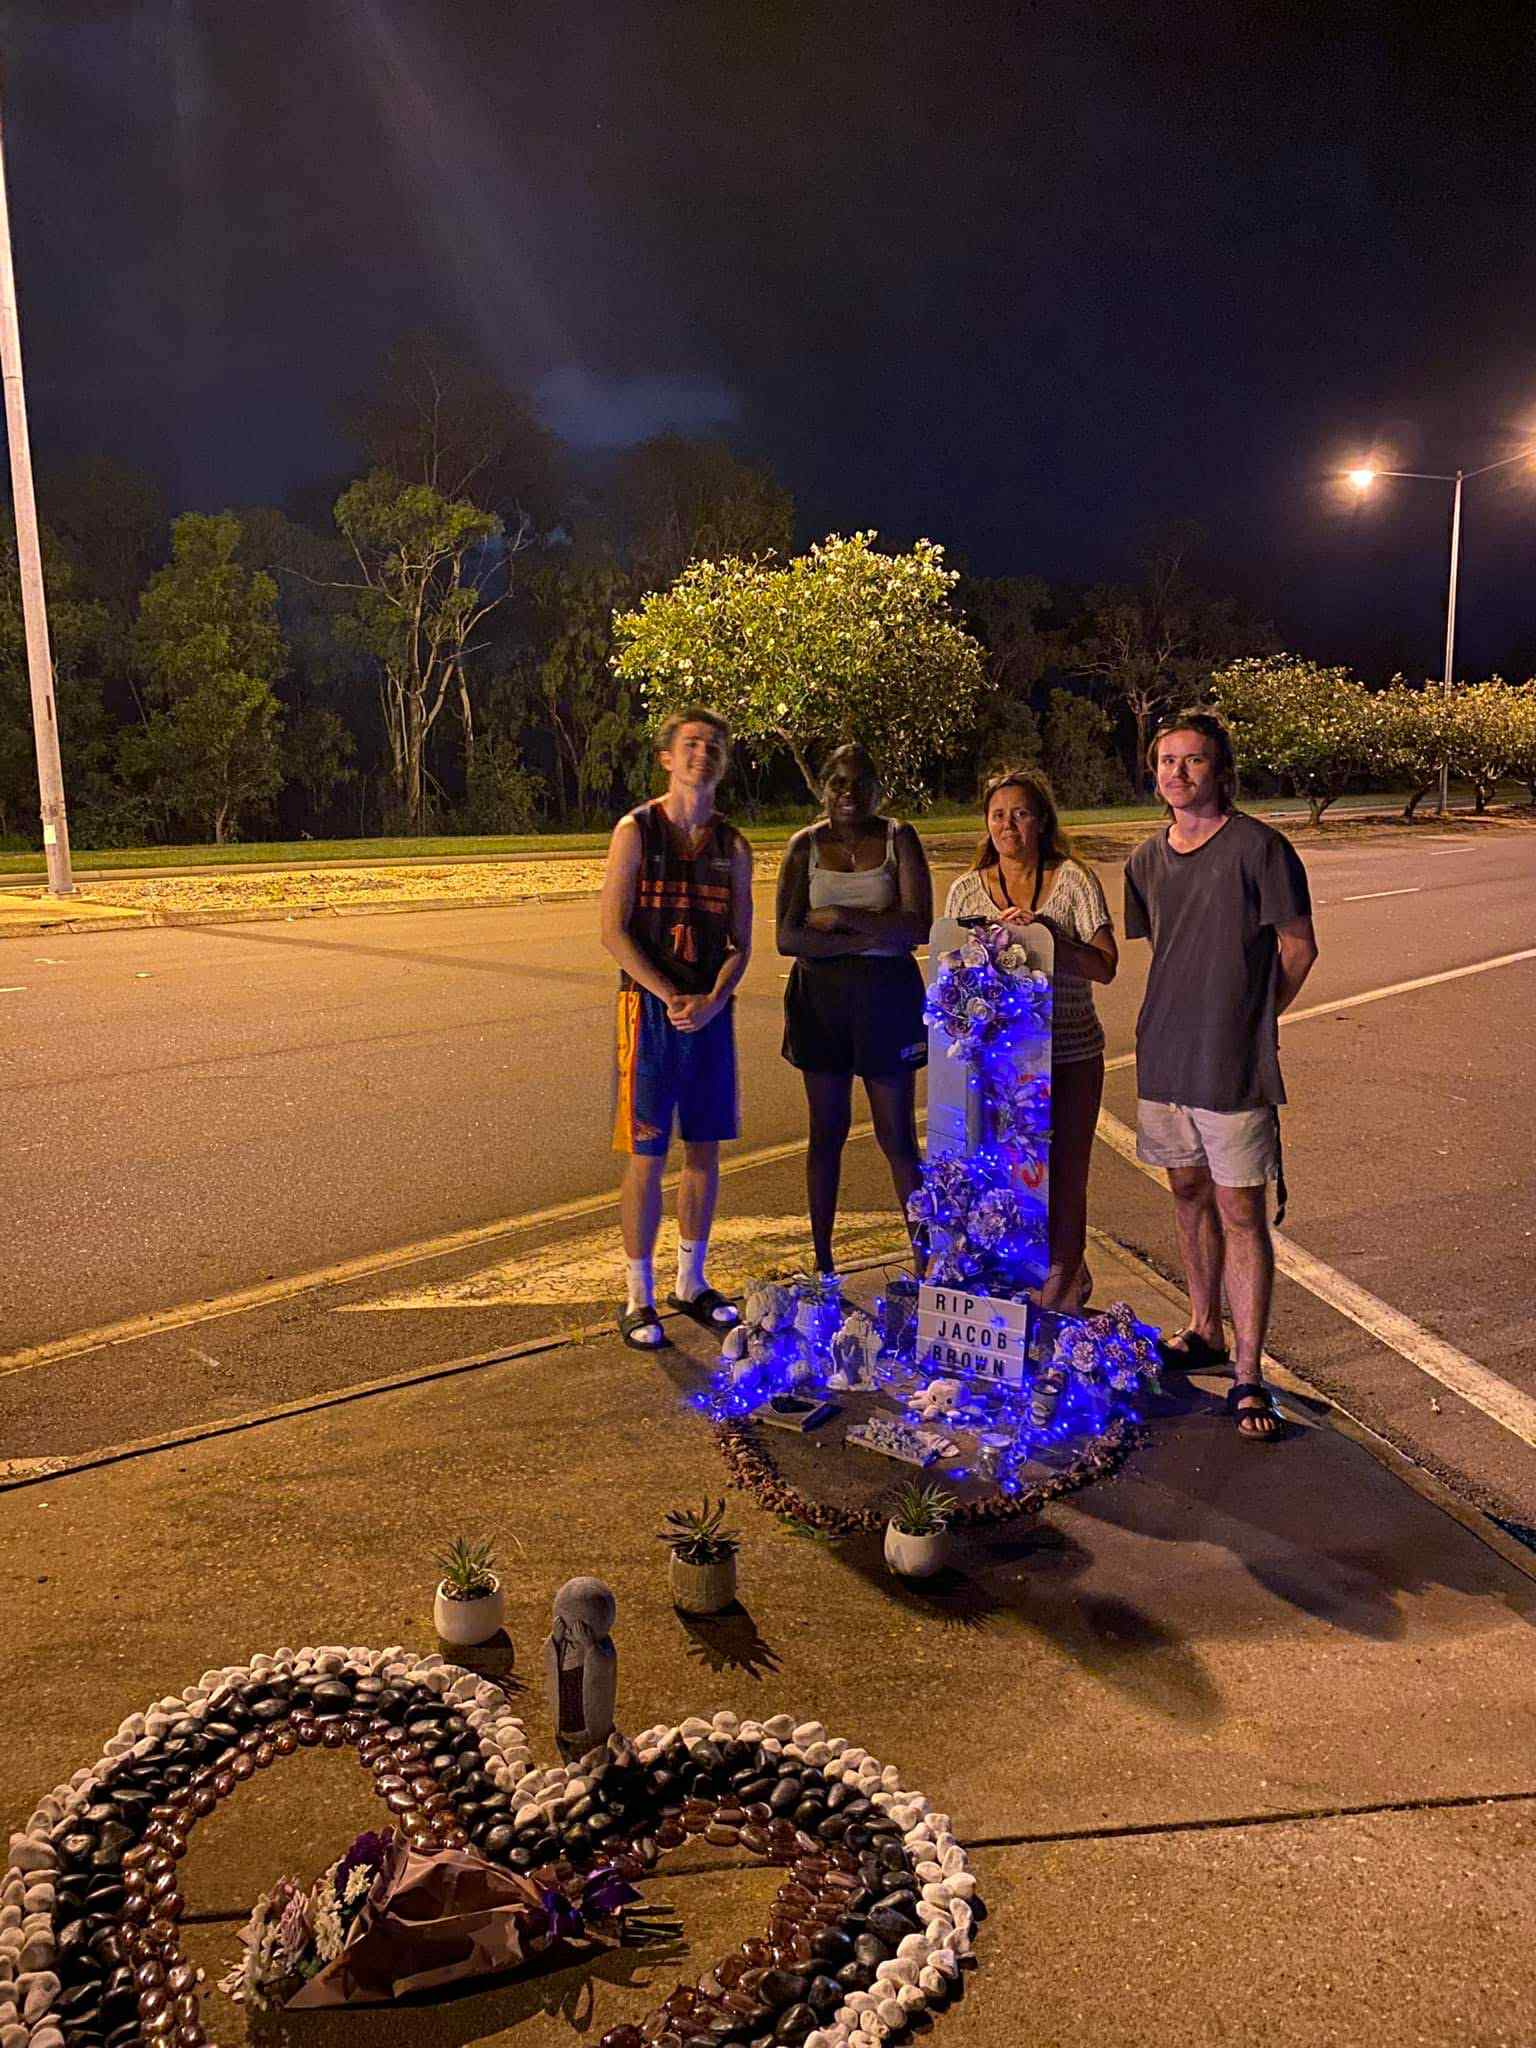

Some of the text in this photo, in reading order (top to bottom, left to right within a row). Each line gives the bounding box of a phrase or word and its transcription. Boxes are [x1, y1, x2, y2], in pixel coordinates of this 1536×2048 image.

[936, 1294, 974, 1315] RIP
[938, 1321, 1007, 1349] JACOB
[932, 1345, 1004, 1377] BROWN
